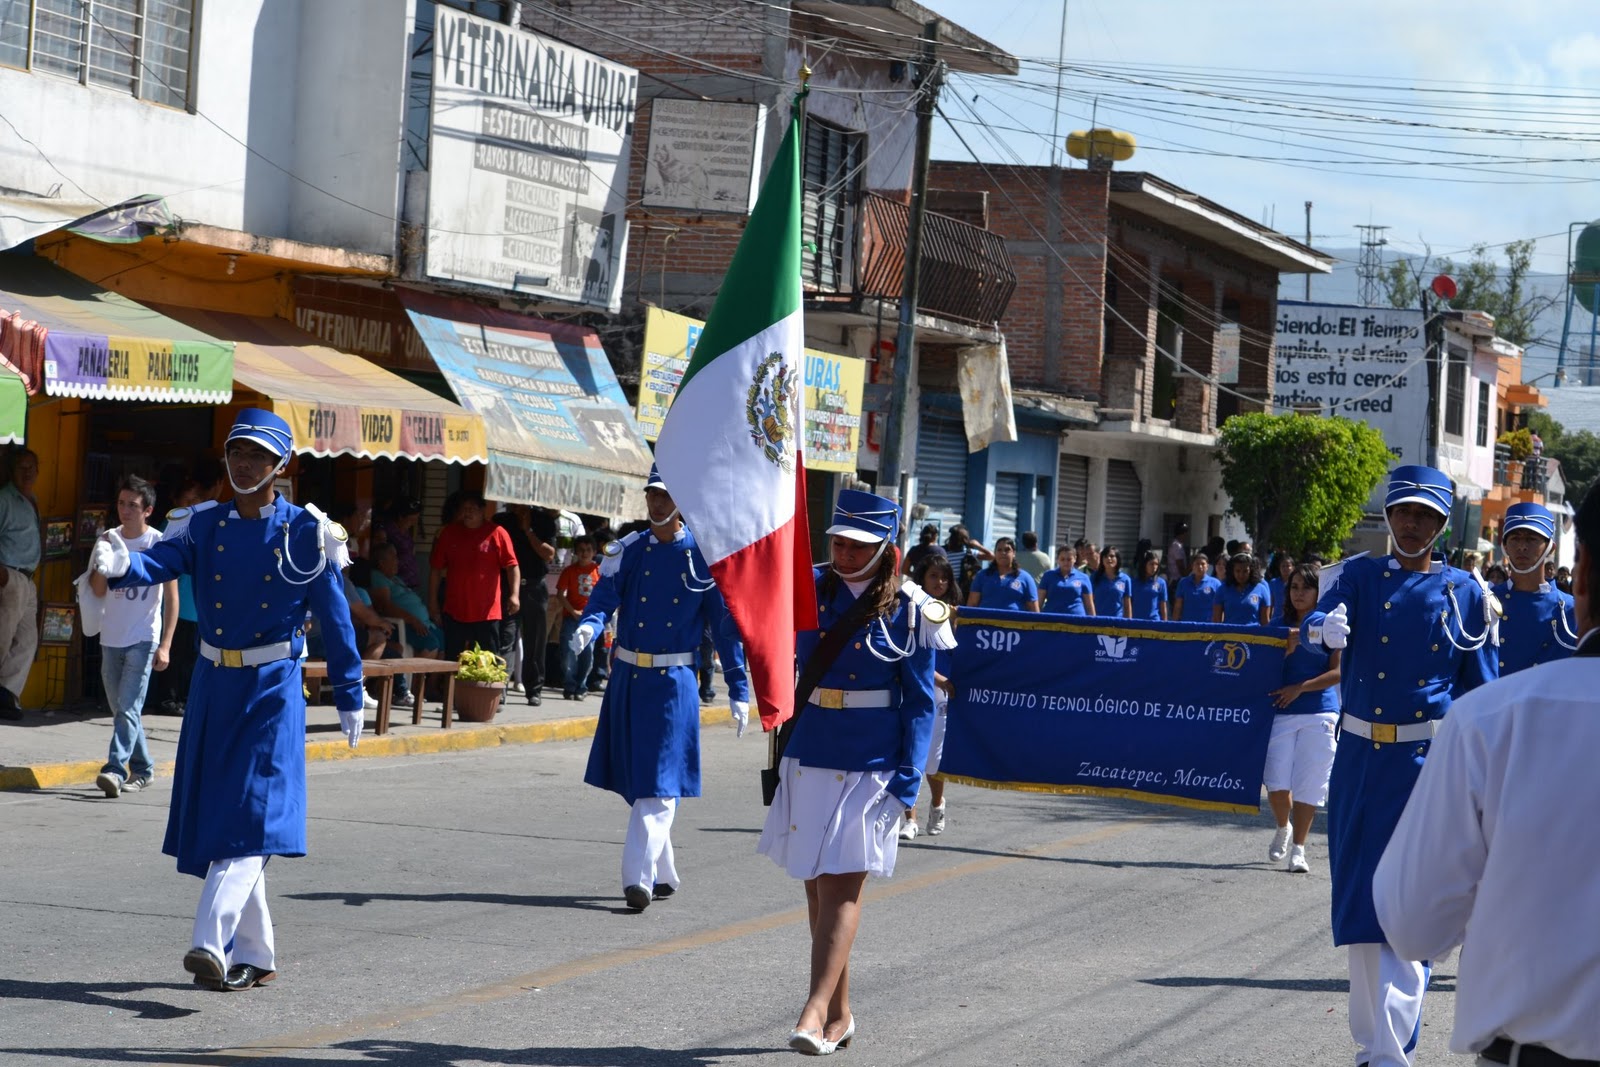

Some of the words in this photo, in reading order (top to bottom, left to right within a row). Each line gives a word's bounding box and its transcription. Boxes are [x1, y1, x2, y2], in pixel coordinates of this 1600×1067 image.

[440, 12, 576, 117] VETERINARIA
[581, 59, 637, 135] URIBE
[508, 151, 515, 172] X
[516, 153, 539, 179] PARA
[540, 159, 551, 182] SU
[552, 162, 589, 191] MASCOTA
[296, 307, 392, 354] VETERINARIA
[1338, 316, 1357, 337] El
[1361, 315, 1419, 345] tiempo
[77, 344, 130, 380] PAÑALERIA
[148, 348, 200, 382] PAÑALITOS
[521, 349, 564, 370] CANINA
[1338, 347, 1349, 367] y
[1351, 343, 1366, 362] el
[1329, 397, 1340, 416] y
[1343, 393, 1393, 413] creed
[361, 413, 393, 443] VIDEO
[585, 479, 626, 516] URIBE
[578, 574, 593, 597] 8
[968, 687, 1037, 710] INSTITUTO
[1041, 693, 1139, 716] TECNOLÓGICO
[1144, 702, 1161, 718] DE
[1166, 703, 1251, 724] ZACATEPEC
[1077, 761, 1168, 788] Zacatepec,
[1173, 769, 1246, 791] Morelos.
